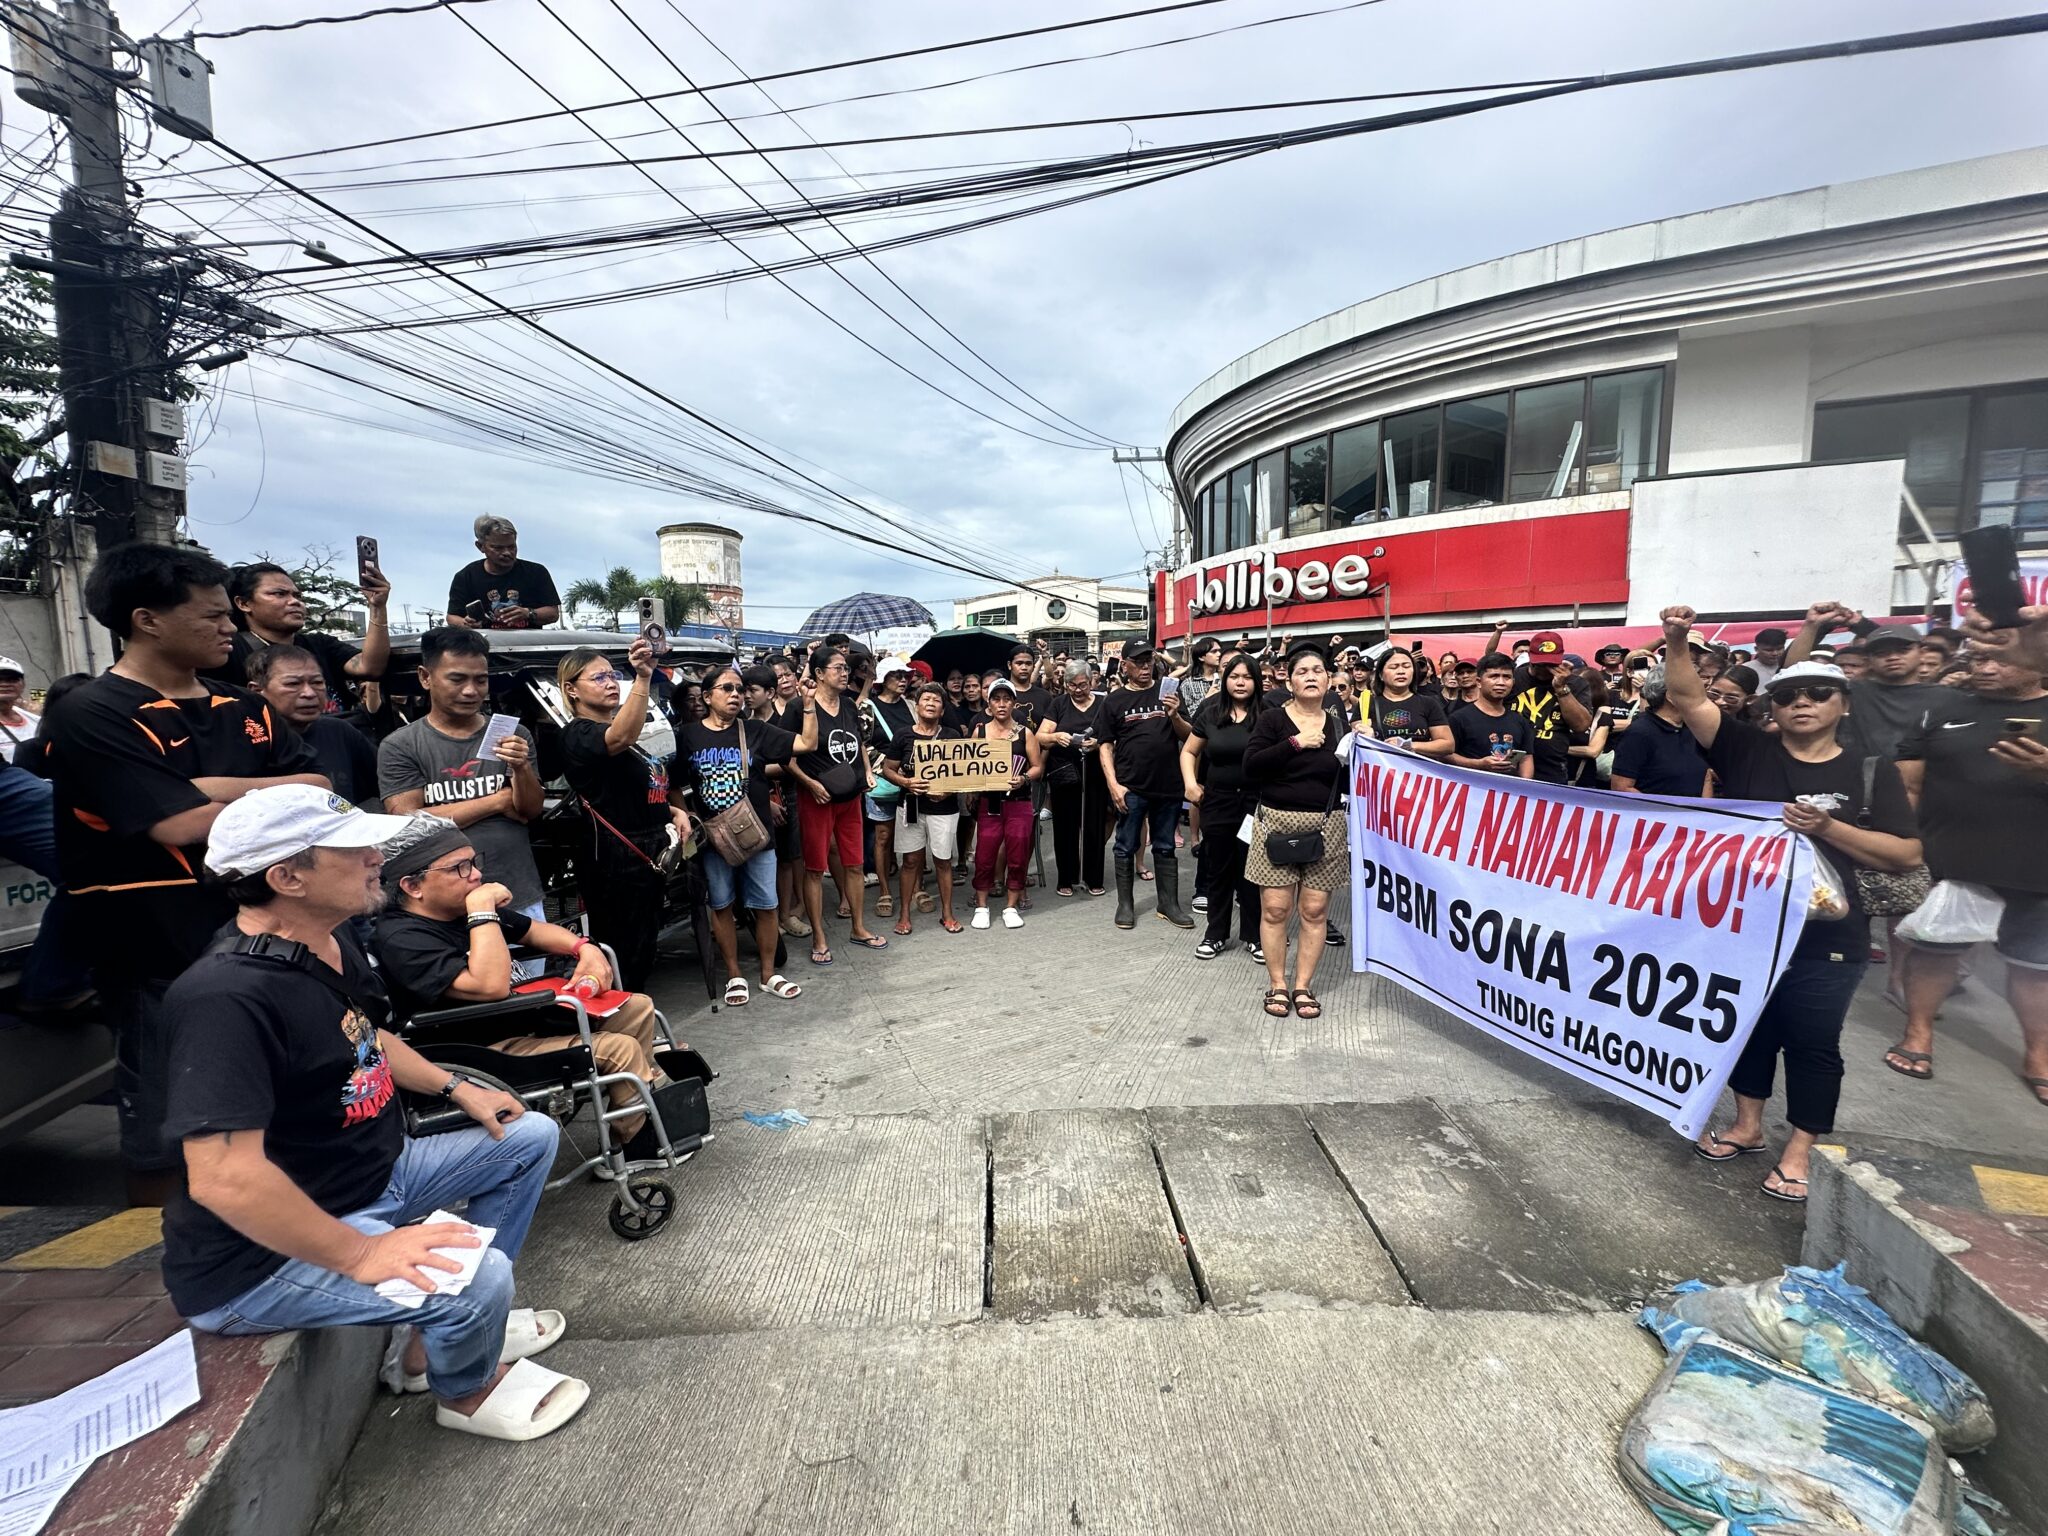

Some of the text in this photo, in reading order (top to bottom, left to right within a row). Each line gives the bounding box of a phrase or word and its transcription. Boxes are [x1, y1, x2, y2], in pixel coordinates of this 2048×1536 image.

[1187, 551, 1370, 617] Jollibee
[917, 742, 991, 763] WALANG
[920, 761, 1009, 781] GALANG
[424, 773, 505, 804] HOLLISTER
[1467, 788, 1621, 901] NAMAN
[1448, 899, 1571, 993] SONA
[1588, 943, 1741, 1043] 2025
[1476, 979, 1555, 1039] TINDIG
